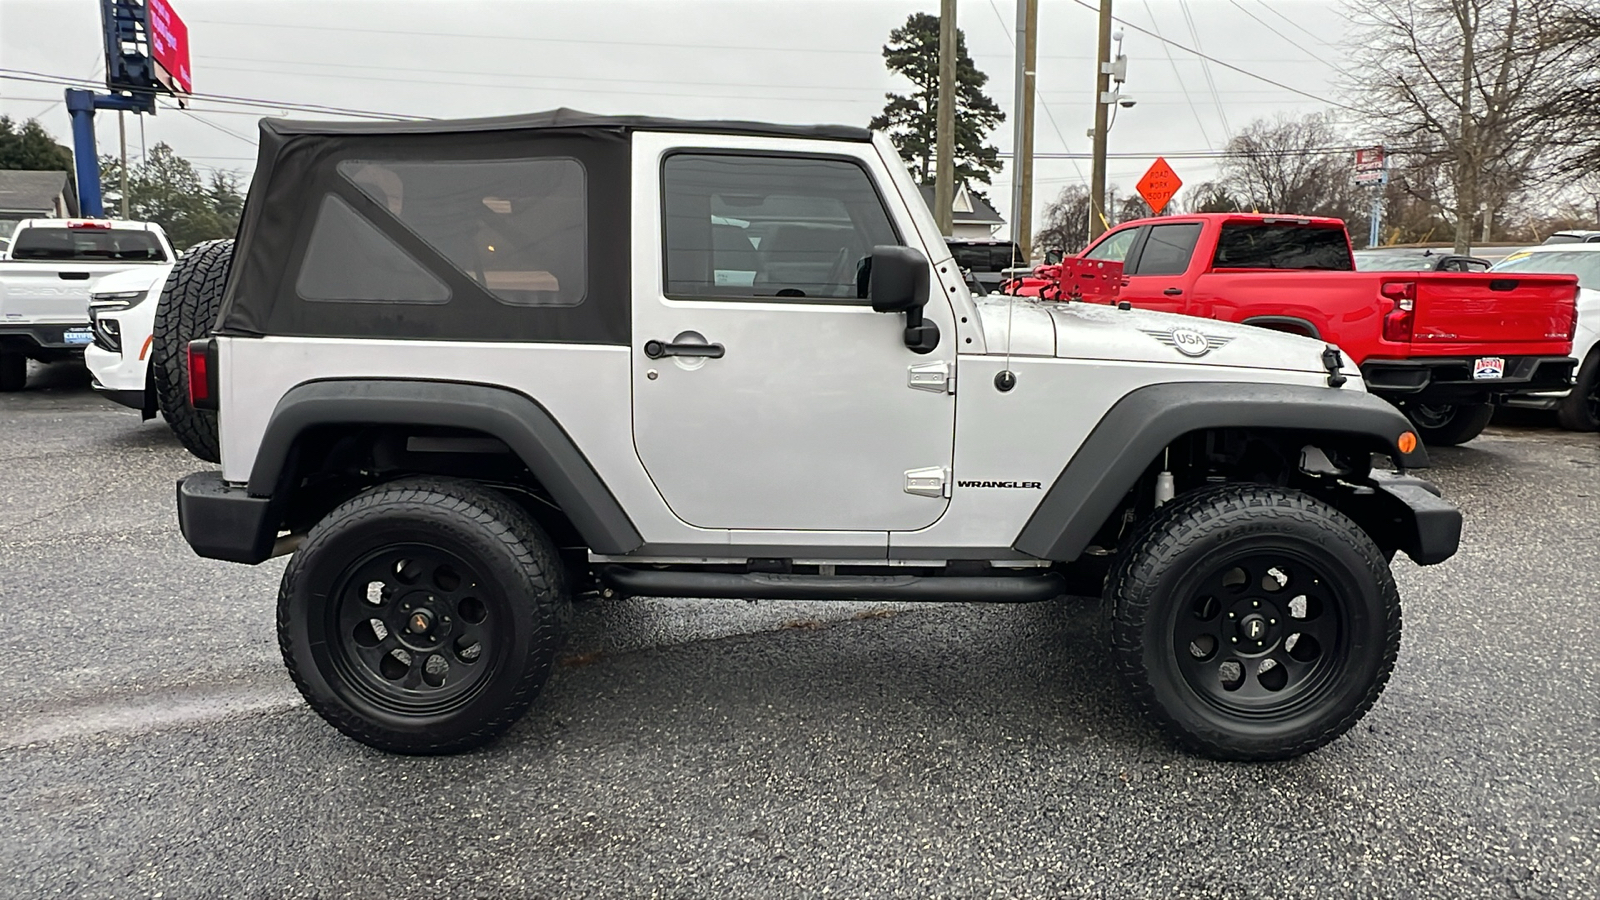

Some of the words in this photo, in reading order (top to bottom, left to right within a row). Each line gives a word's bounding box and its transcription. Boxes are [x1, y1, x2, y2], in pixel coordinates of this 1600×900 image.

[1150, 171, 1169, 179] ROAD
[1149, 181, 1169, 189] WORK
[1176, 333, 1205, 346] USA
[957, 480, 1042, 490] WRANGLER
